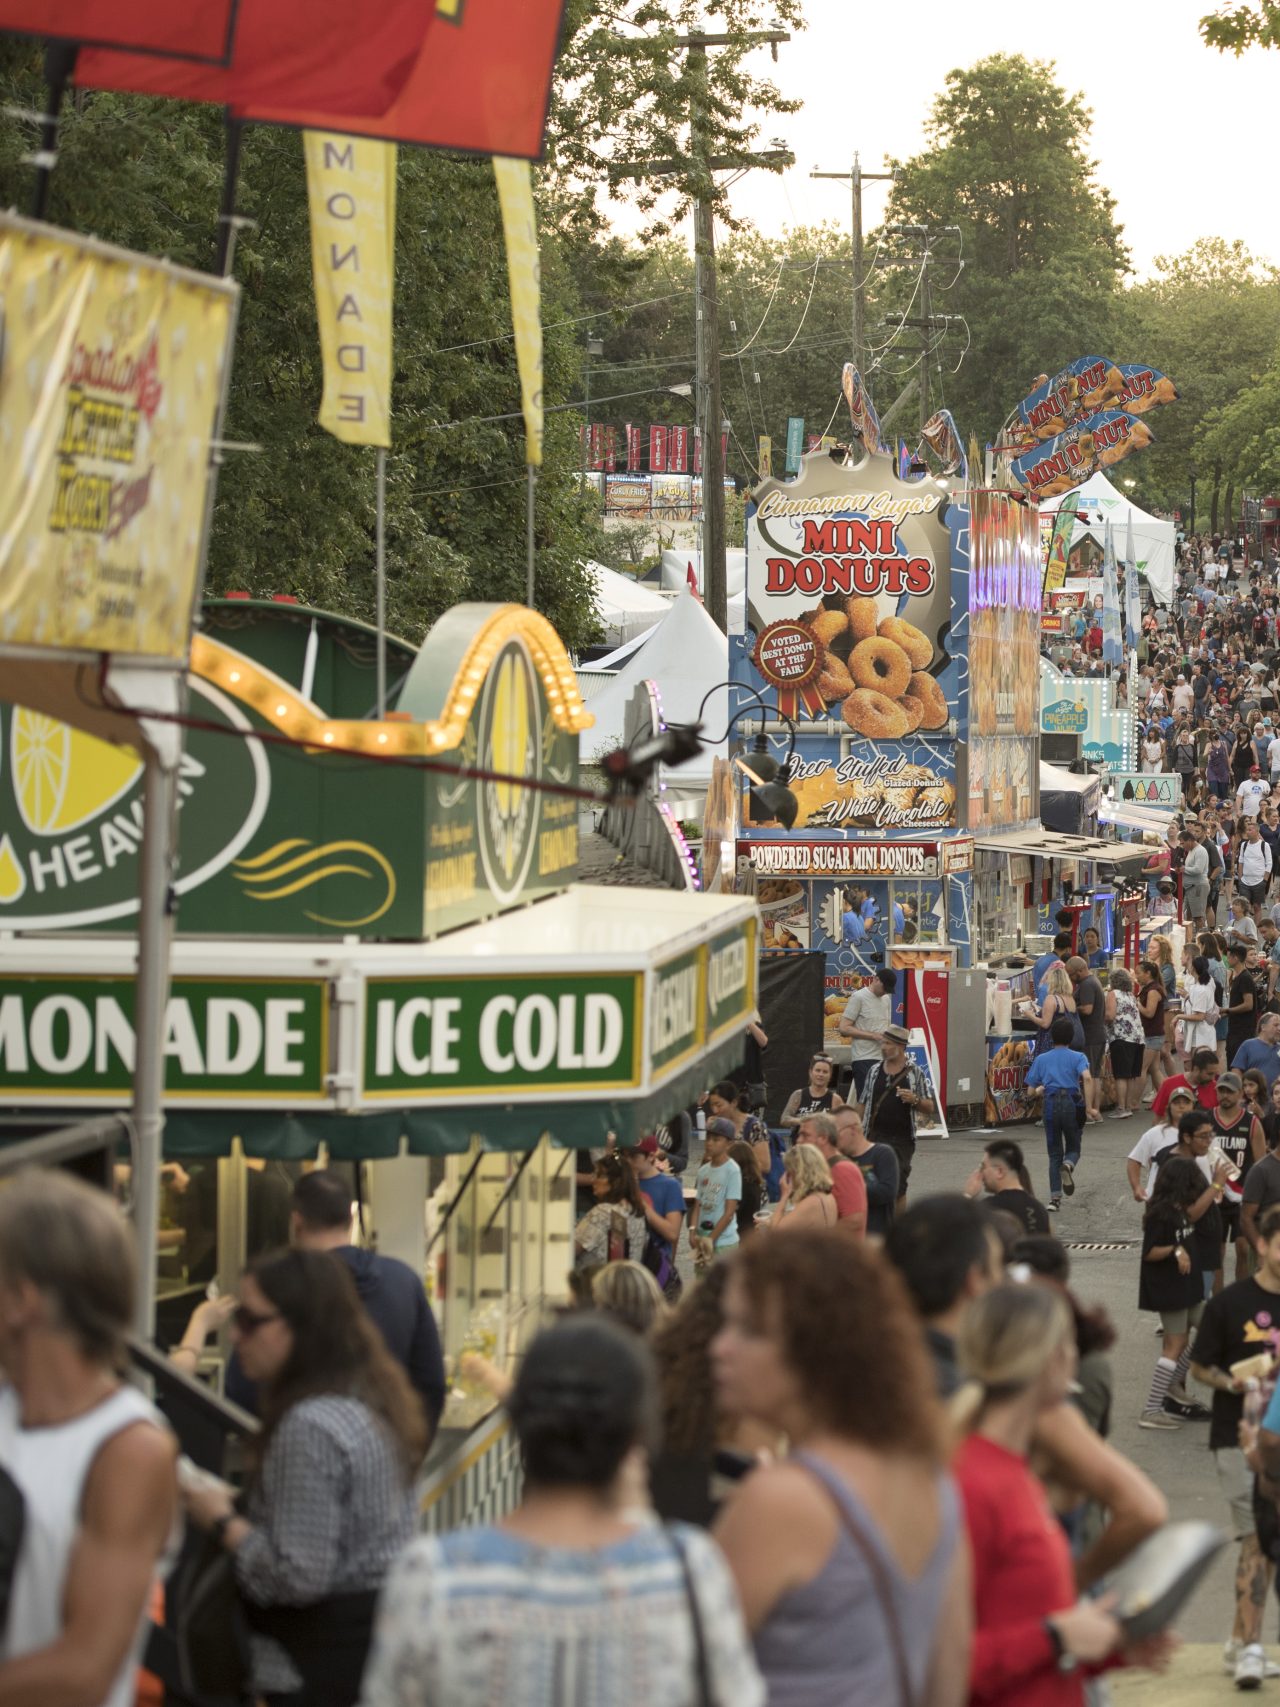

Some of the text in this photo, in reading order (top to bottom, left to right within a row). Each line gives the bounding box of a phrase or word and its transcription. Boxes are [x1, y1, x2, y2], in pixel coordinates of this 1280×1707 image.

[1028, 389, 1062, 431] MINI
[1066, 431, 1079, 442] THE
[1025, 450, 1069, 490] MINI
[631, 488, 647, 496] FRIES
[669, 488, 689, 500] GUYS
[758, 490, 941, 525] Cinnamon Sugar
[801, 520, 896, 554] MINI
[765, 557, 932, 593] DONUTS
[762, 641, 814, 660] BEST DONUT
[771, 634, 801, 648] VOTED
[775, 653, 806, 668] AT THE
[780, 664, 804, 677] FAIR!
[1044, 713, 1086, 725] PINEAPPLE
[835, 752, 907, 788] Stuffed
[884, 778, 944, 788] Glazed Donuts
[823, 796, 950, 828] White Chocolate
[903, 820, 950, 828] Cheesecake
[749, 846, 811, 873] POWDERED
[813, 846, 850, 872] SUGAR
[852, 847, 877, 871] MINI
[880, 846, 925, 871] DONUTS
[375, 993, 625, 1075] ICE COLD
[993, 1066, 1020, 1091] MINI
